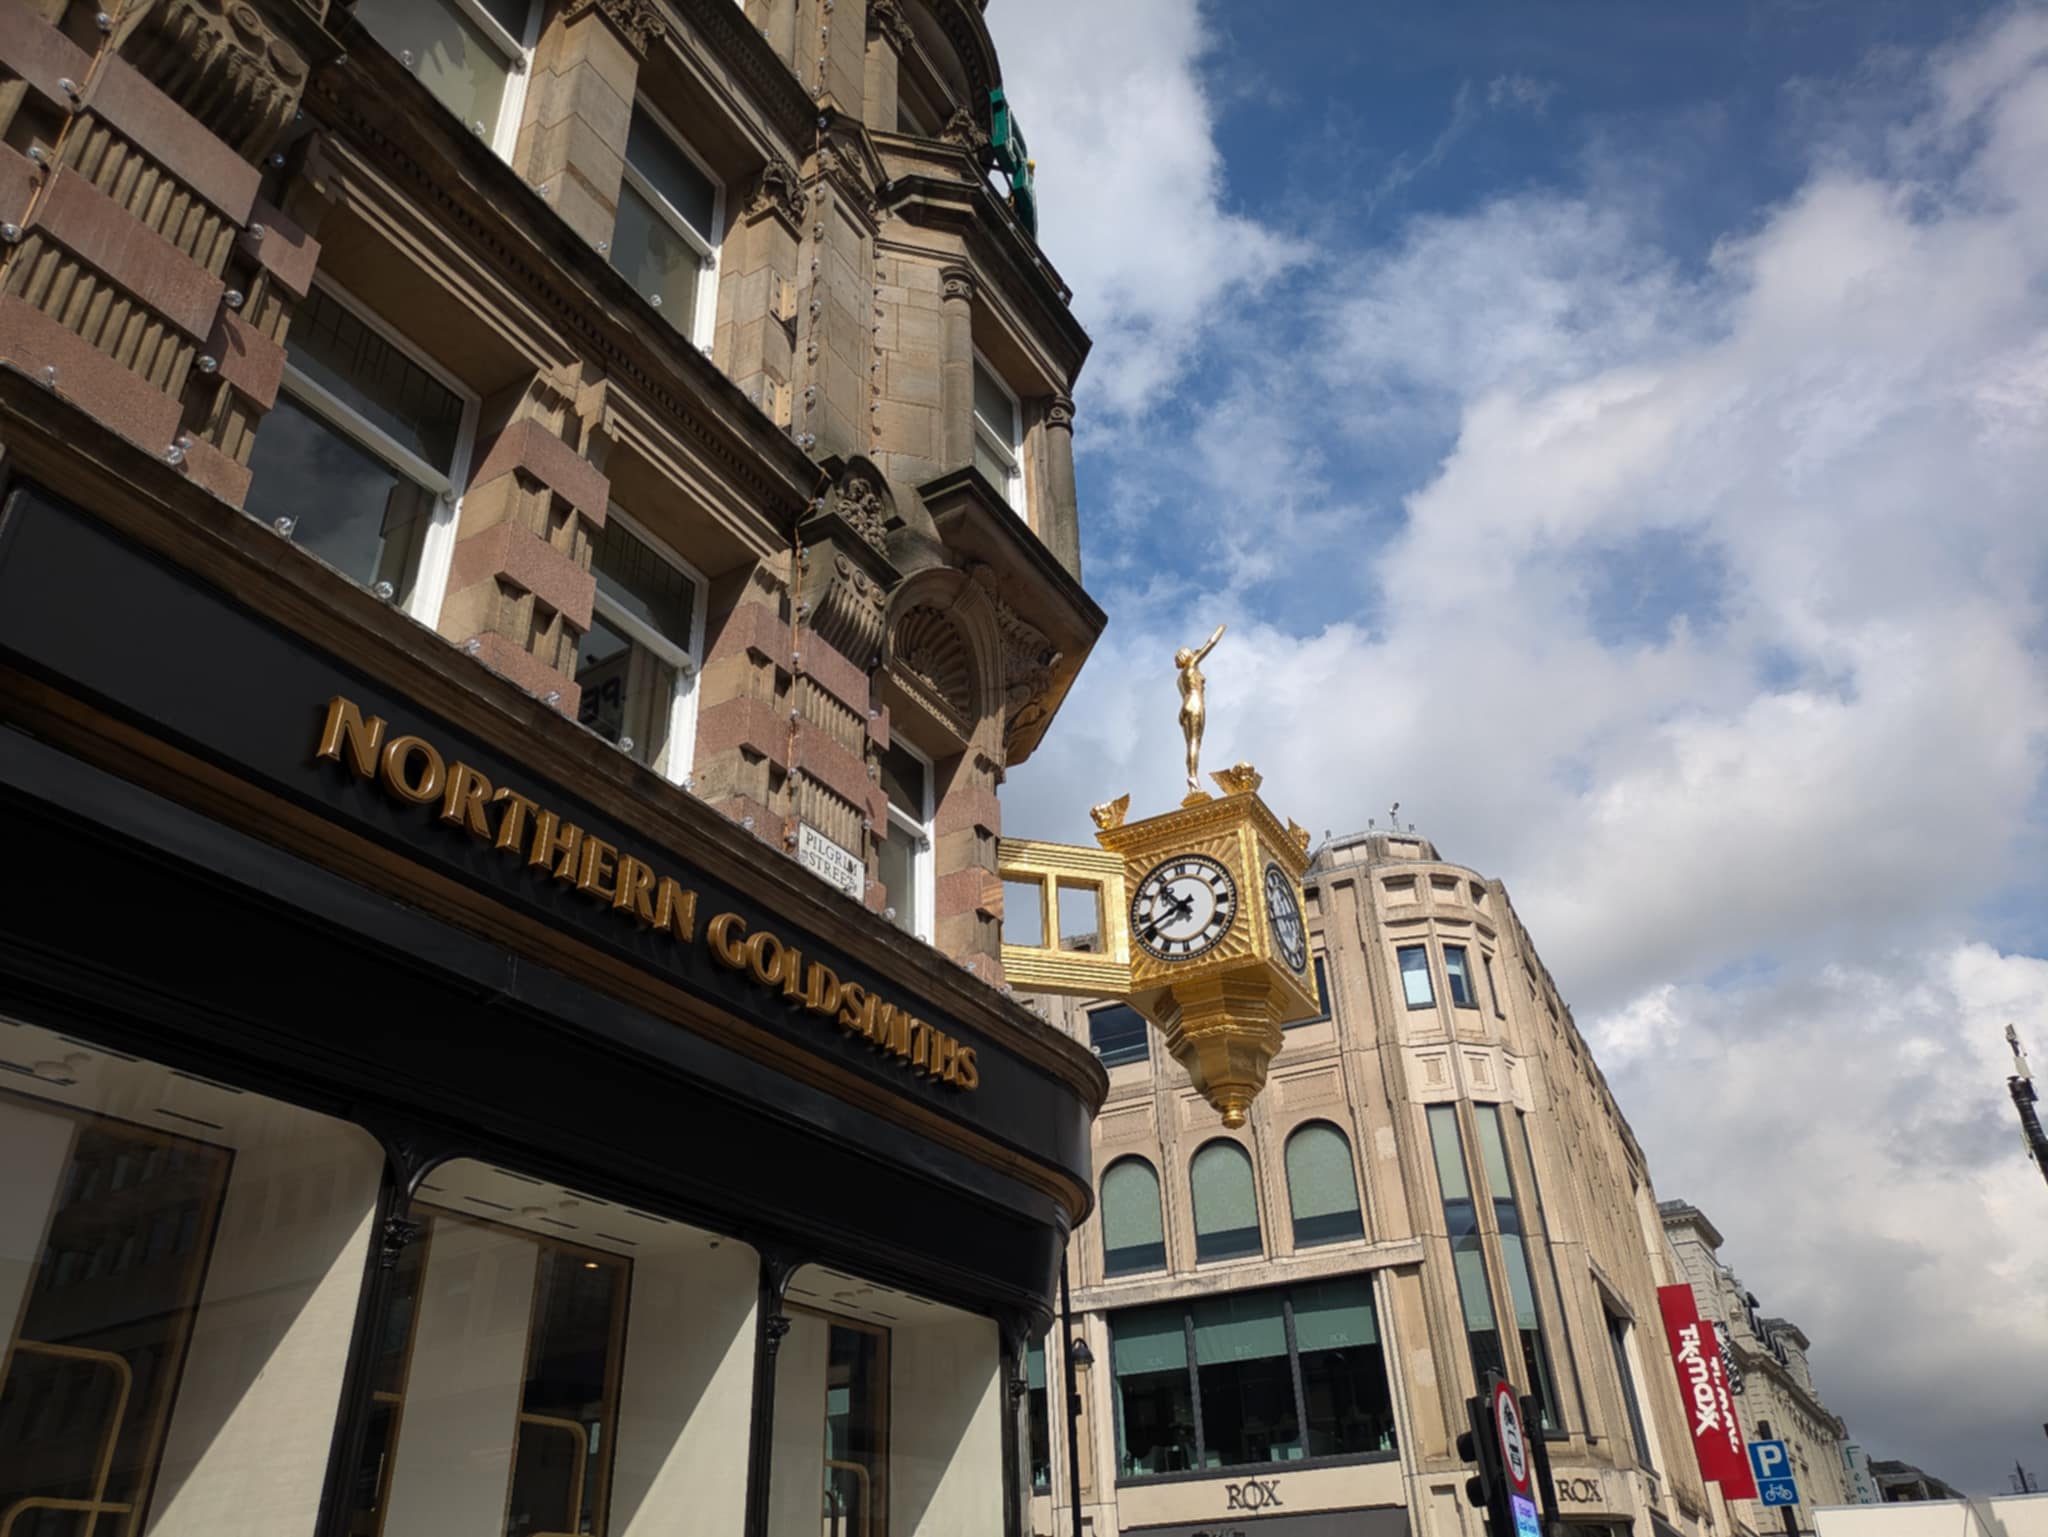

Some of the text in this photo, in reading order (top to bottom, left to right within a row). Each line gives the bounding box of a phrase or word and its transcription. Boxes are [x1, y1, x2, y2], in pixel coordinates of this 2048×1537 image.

[806, 830, 857, 876] PILGRIM
[318, 697, 979, 1089] NORTHERN GOLDSMITHS
[1756, 1444, 1782, 1477] P
[1225, 1480, 1283, 1510] ROX
[1556, 1478, 1602, 1504] ROX
